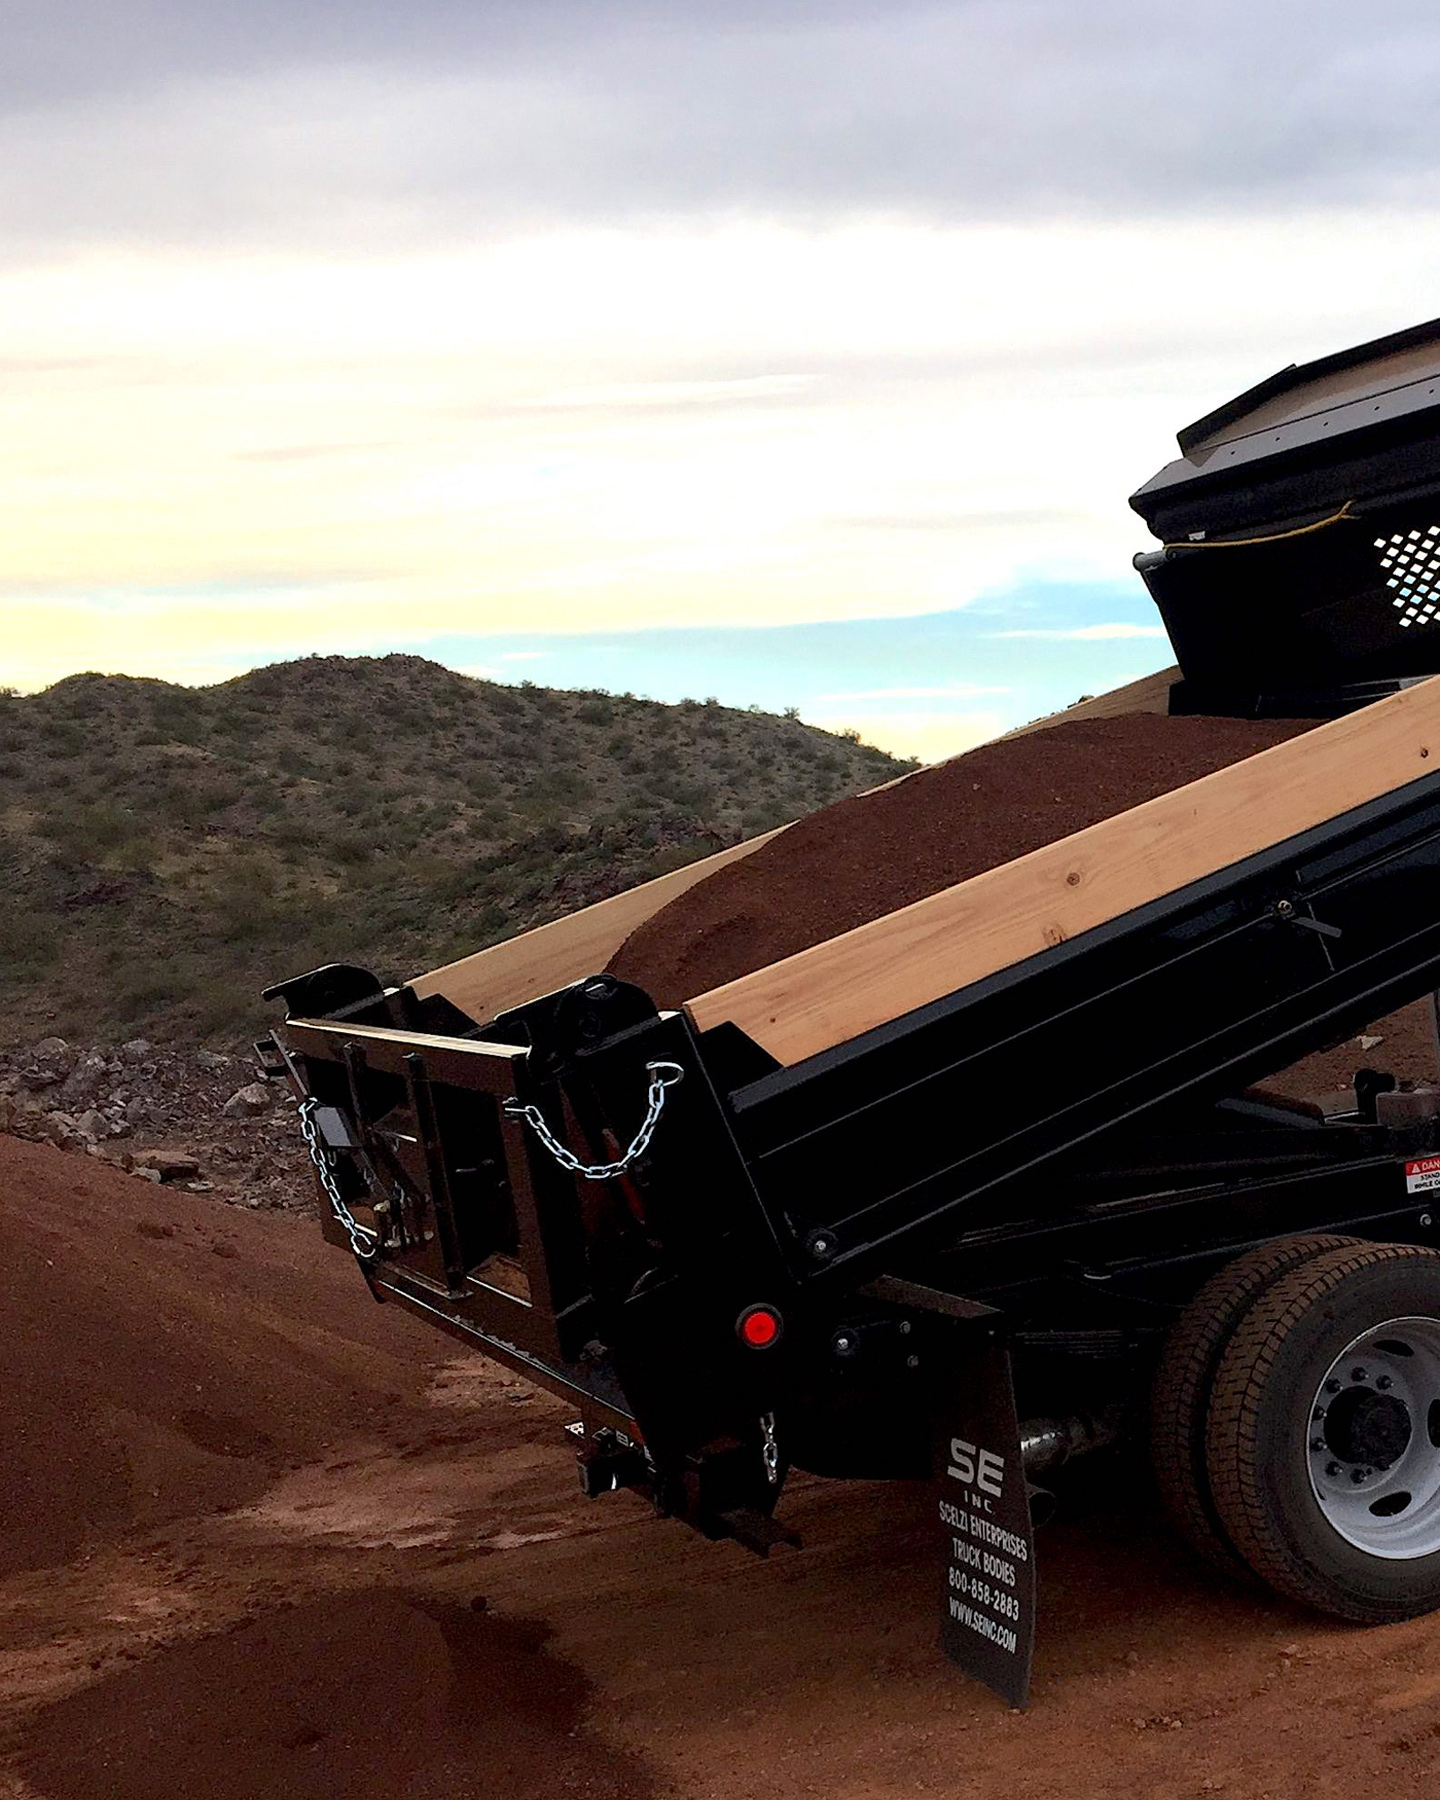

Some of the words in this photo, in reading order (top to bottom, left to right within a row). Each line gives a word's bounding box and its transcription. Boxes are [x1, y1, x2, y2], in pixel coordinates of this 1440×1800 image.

[1420, 1172, 1440, 1180] STAND
[947, 1437, 1005, 1498] SE
[939, 1500, 969, 1532] SCELZI
[970, 1514, 1028, 1562] ENTERPRISES
[952, 1537, 982, 1570] TRUCK
[983, 1551, 1016, 1588] BODIES
[948, 1566, 1019, 1621] 800-858-2883
[949, 1596, 1017, 1654] WWW.SEINC.COM
